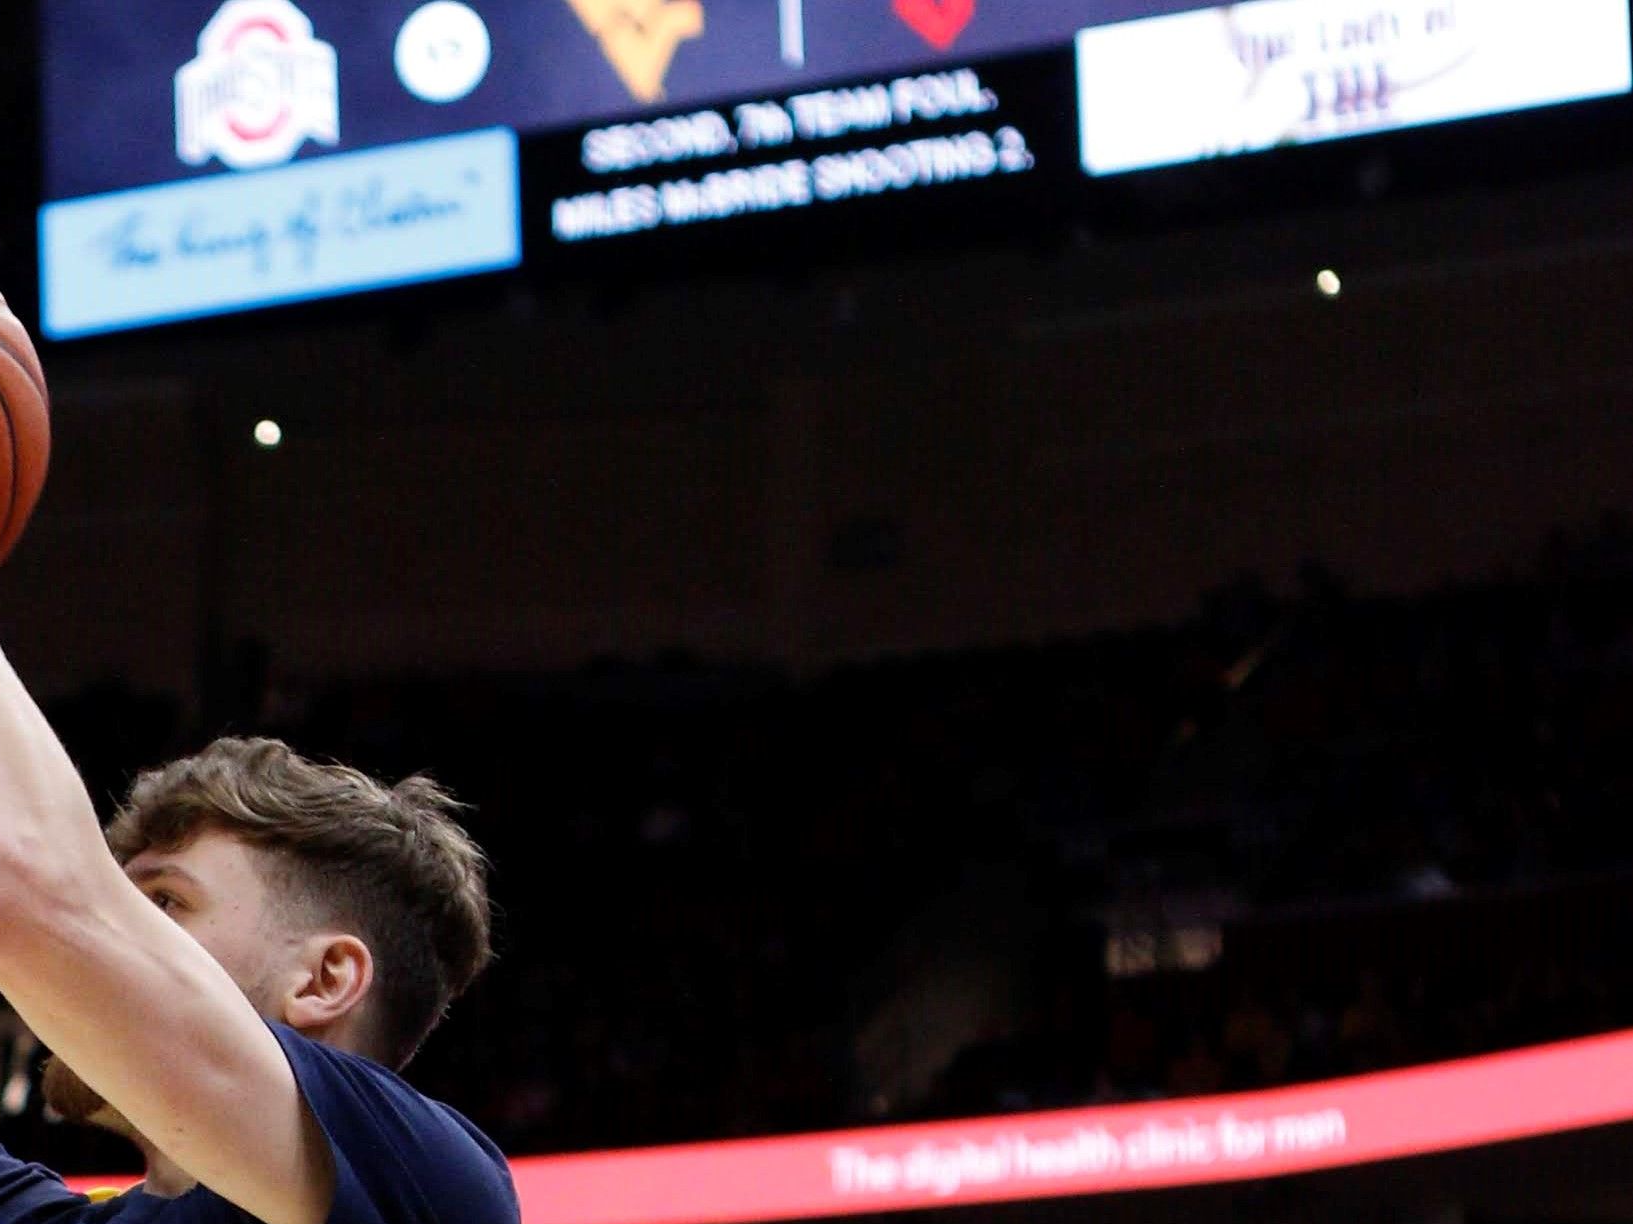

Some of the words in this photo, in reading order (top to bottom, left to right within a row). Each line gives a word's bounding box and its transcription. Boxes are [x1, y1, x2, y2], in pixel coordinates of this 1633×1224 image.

[786, 84, 892, 140] TEAM
[552, 183, 661, 243] MILES
[811, 130, 998, 200] SHOOTING
[830, 1146, 897, 1194] The
[903, 1136, 1010, 1198] digital
[1016, 1126, 1121, 1178] health
[1272, 1108, 1346, 1152] men
